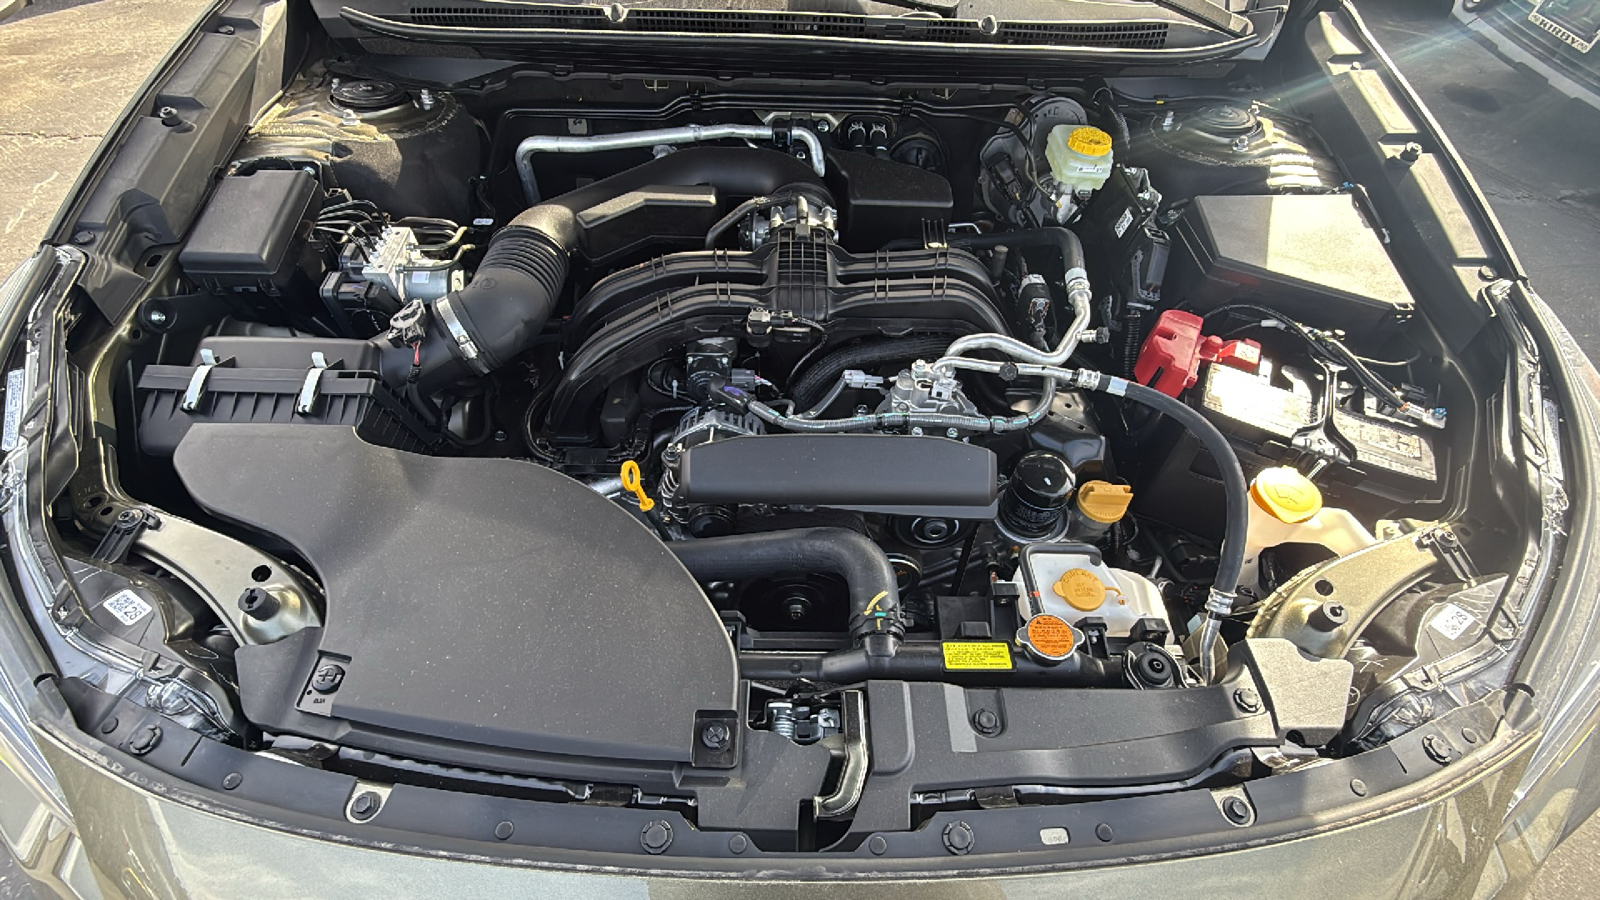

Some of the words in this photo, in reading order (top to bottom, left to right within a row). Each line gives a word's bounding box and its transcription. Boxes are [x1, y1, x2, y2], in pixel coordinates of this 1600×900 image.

[1539, 19, 1579, 45] KIRBY
[1062, 570, 1099, 584] COOLANT
[123, 606, 142, 621] 28
[1451, 611, 1468, 625] 28
